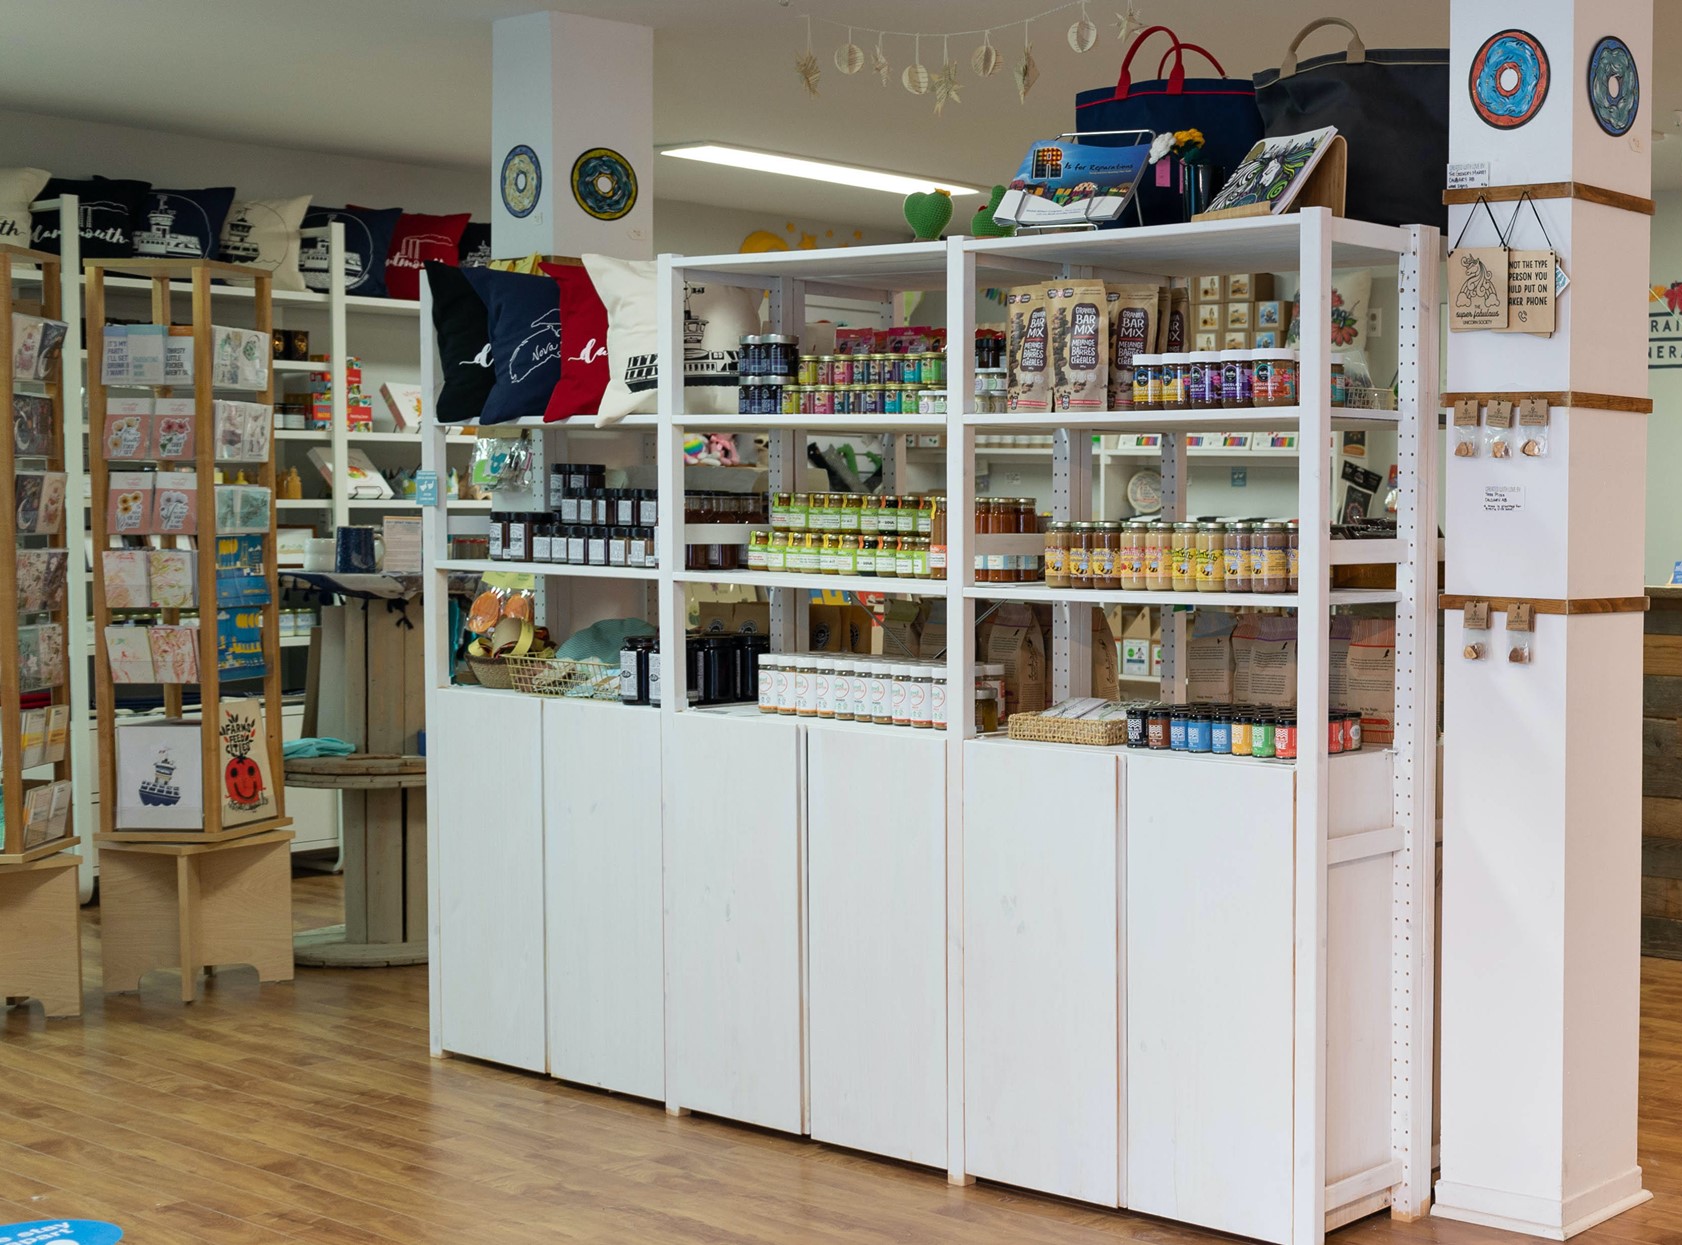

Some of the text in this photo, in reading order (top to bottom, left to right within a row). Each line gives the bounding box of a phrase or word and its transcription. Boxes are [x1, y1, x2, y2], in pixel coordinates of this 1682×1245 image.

[1075, 163, 1085, 171] for
[1535, 260, 1547, 268] TYPE
[1509, 272, 1547, 281] PERSON YOU
[1524, 285, 1535, 293] PUT
[1538, 284, 1547, 292] ON
[1526, 297, 1547, 306] PHONE
[1473, 309, 1499, 318] fabulous
[1031, 318, 1044, 327] BAR
[1075, 315, 1096, 324] BAR
[1122, 318, 1144, 328] BAR
[1027, 328, 1044, 338] MIX
[1074, 325, 1095, 334] MIX
[1120, 328, 1144, 337] MIX
[532, 343, 558, 361] Nova
[17, 1222, 70, 1238] stay
[5, 1229, 74, 1245] part
